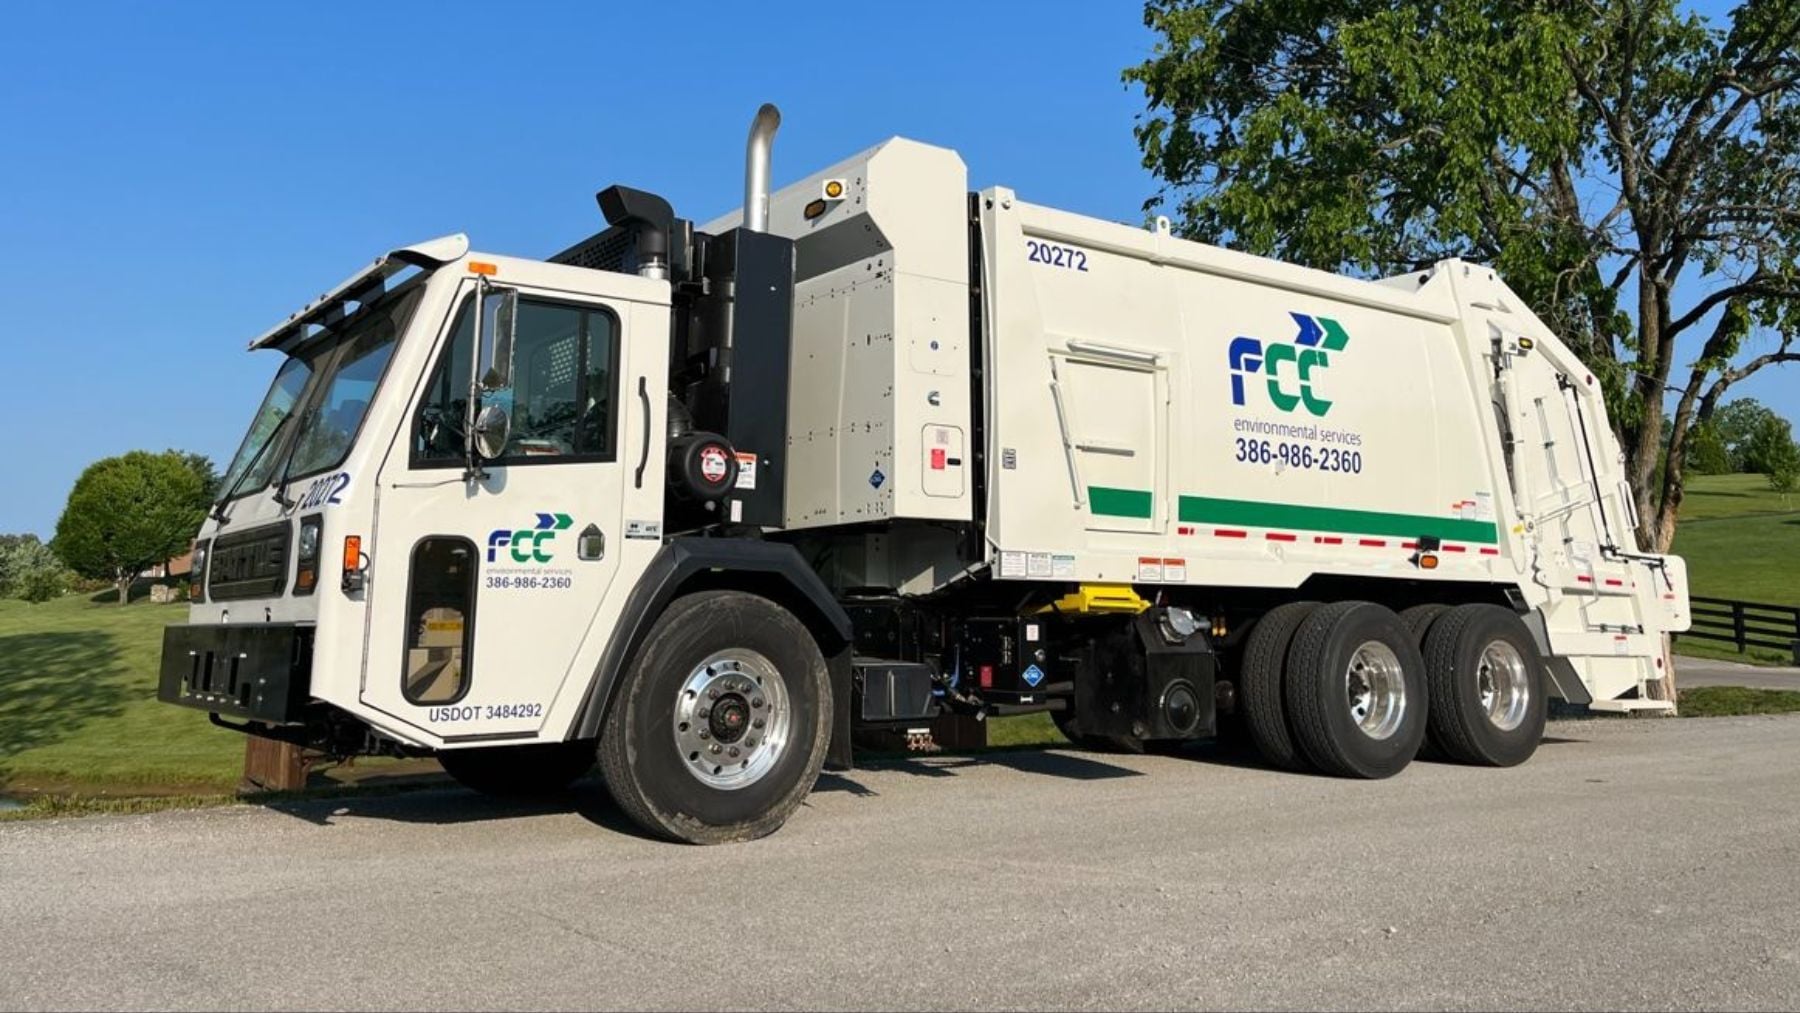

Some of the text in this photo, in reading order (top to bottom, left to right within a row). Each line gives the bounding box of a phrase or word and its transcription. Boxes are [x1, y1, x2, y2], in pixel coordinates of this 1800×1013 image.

[1027, 240, 1088, 272] 20272
[1229, 336, 1333, 417] FCC
[1234, 417, 1362, 446] environmental services
[1236, 437, 1362, 474] 386-986-2360
[301, 472, 350, 509] 20272
[487, 529, 556, 563] FCC
[486, 576, 572, 589] 386-986-2360
[429, 703, 542, 723] USDOT 3484292
